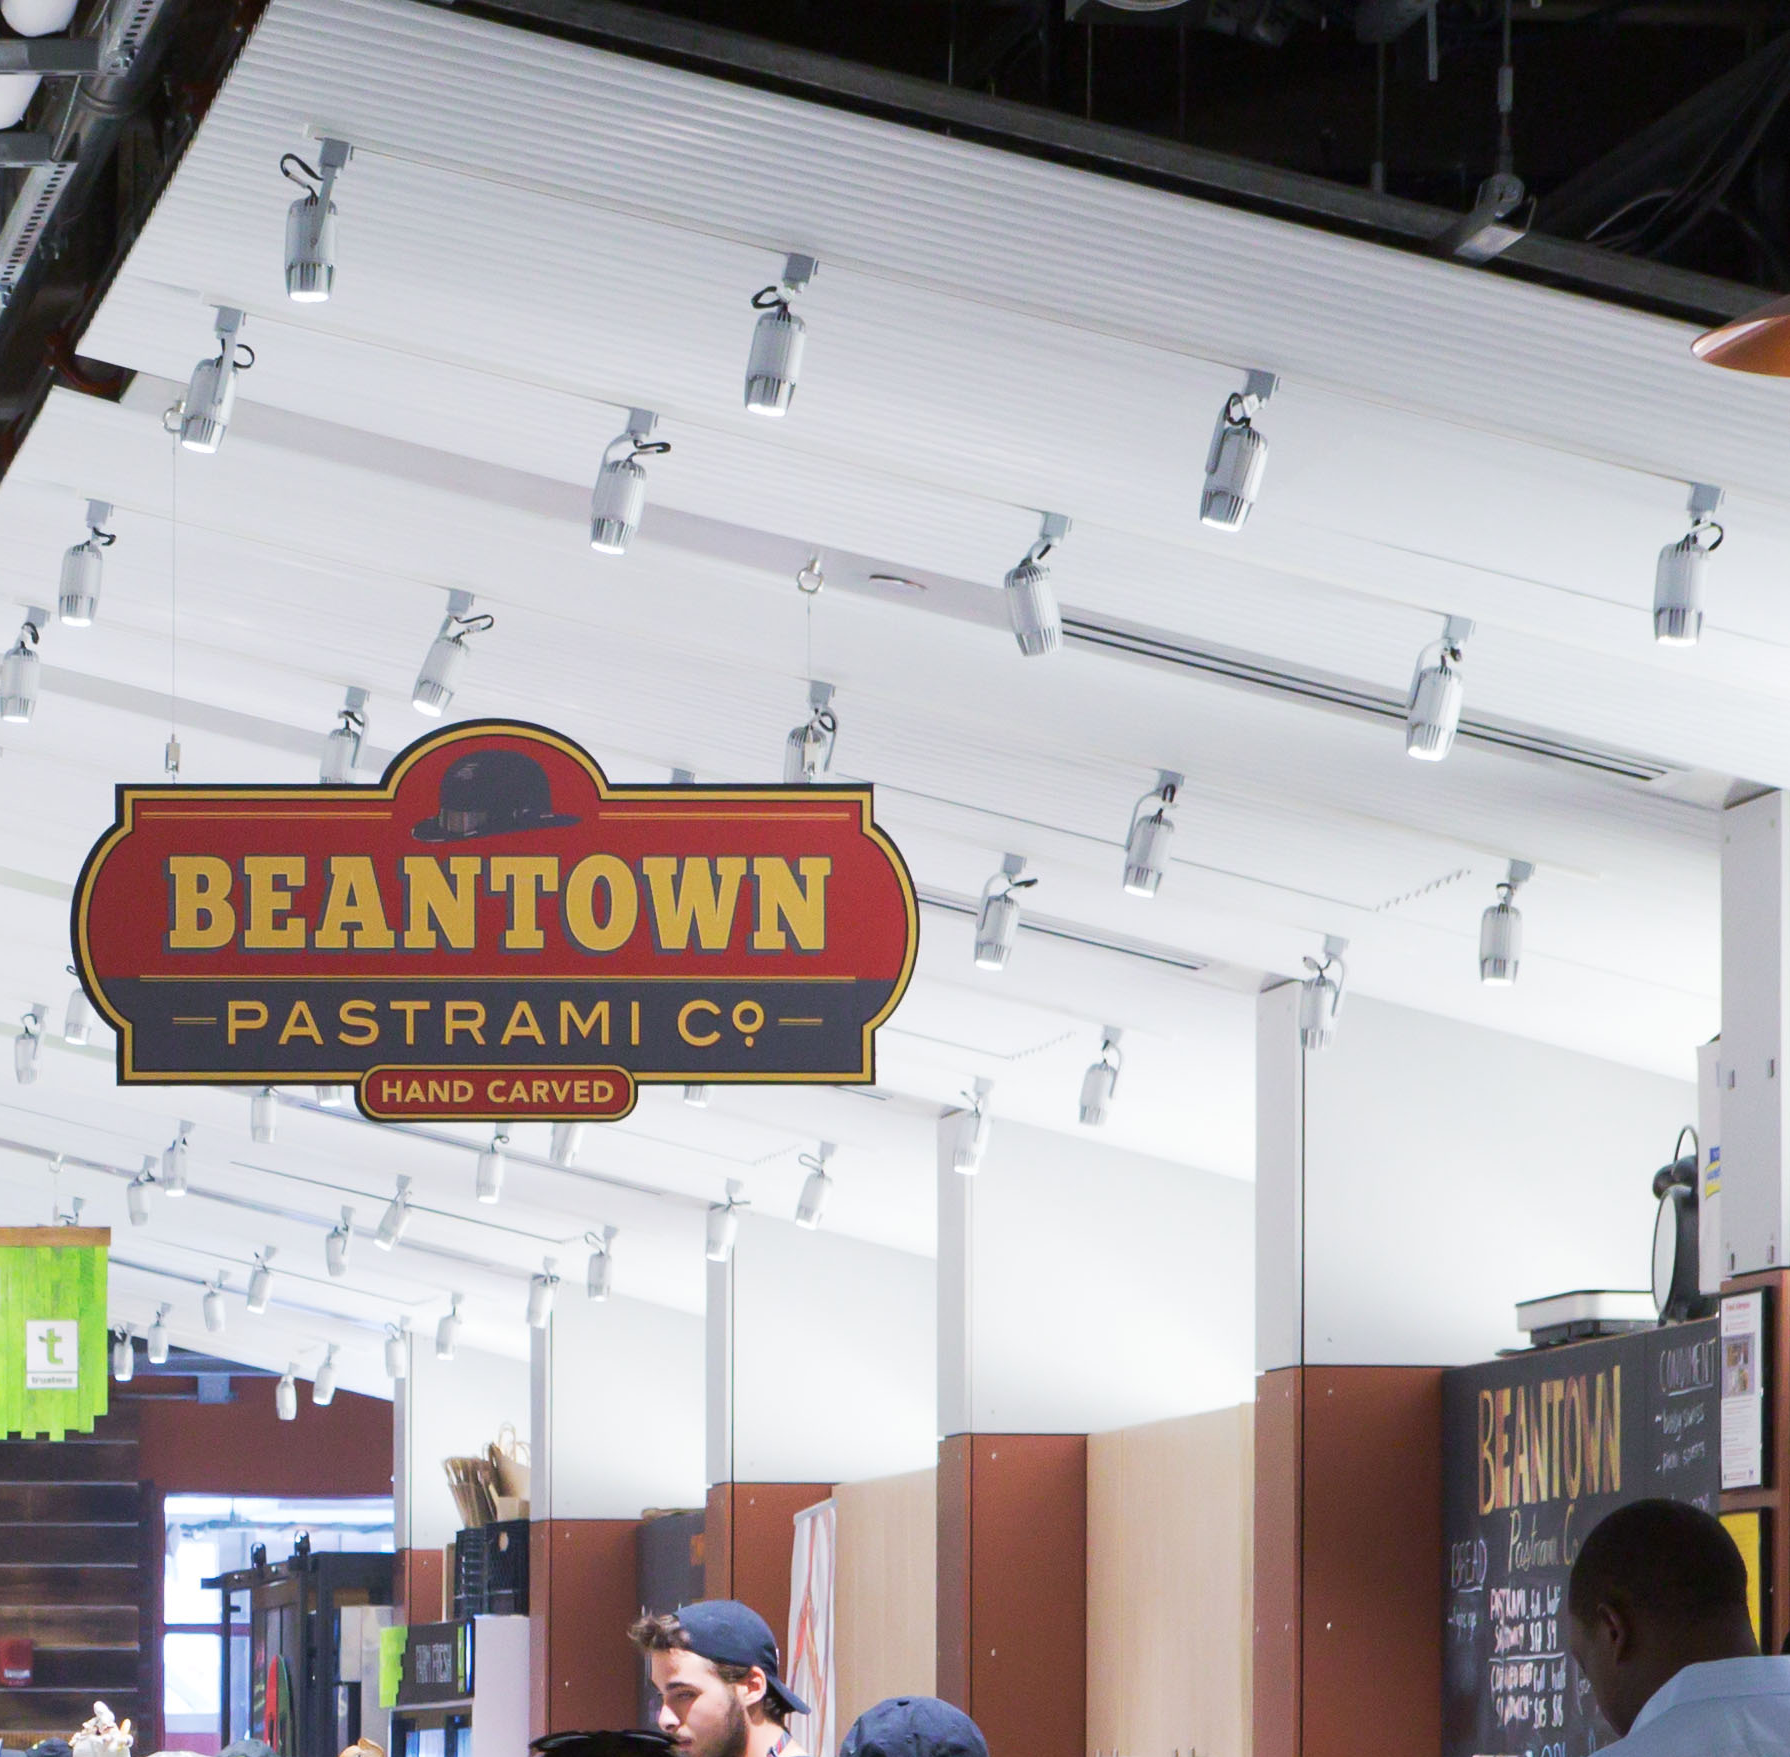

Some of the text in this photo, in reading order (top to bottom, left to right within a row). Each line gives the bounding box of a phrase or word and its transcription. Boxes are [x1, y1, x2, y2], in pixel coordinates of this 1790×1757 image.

[166, 855, 832, 953] BEANTOWN
[227, 1000, 641, 1046] PASTRAMI
[380, 1080, 615, 1104] HAND CARVED
[1478, 1364, 1621, 1516] BEANTOWN
